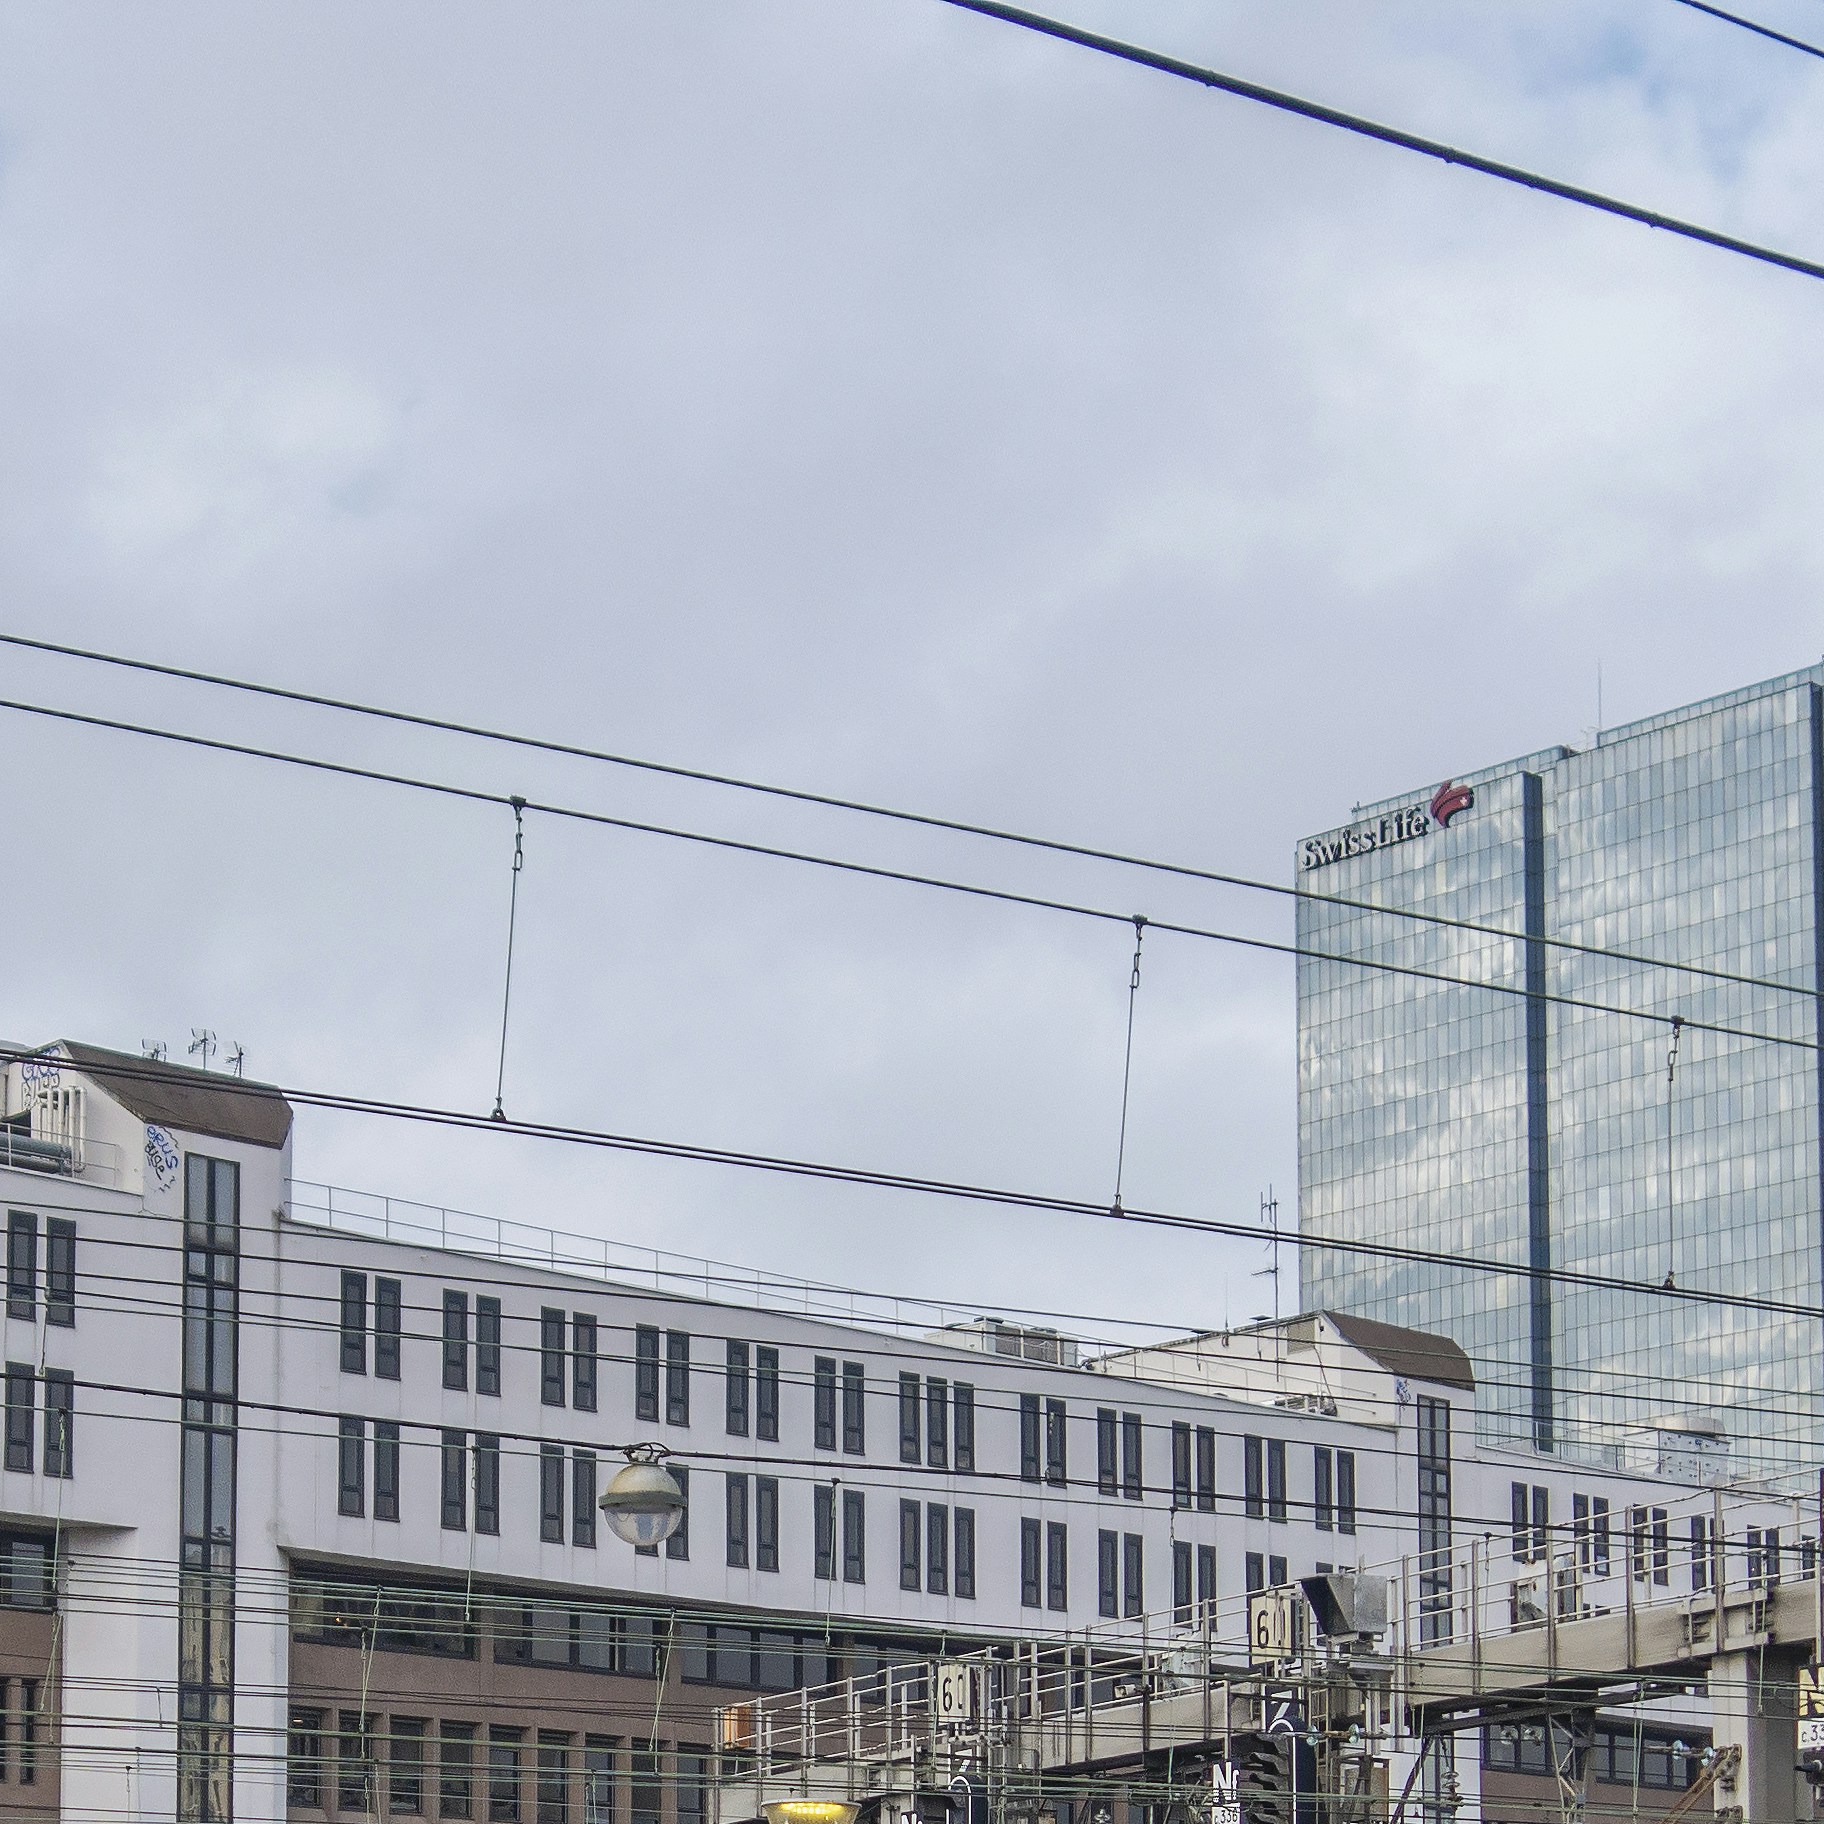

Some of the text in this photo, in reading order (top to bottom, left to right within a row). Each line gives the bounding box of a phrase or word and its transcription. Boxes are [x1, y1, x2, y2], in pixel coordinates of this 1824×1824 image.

[1302, 805, 1430, 870] SwissLife
[1256, 1609, 1285, 1649] 60
[942, 1674, 964, 1712] 60
